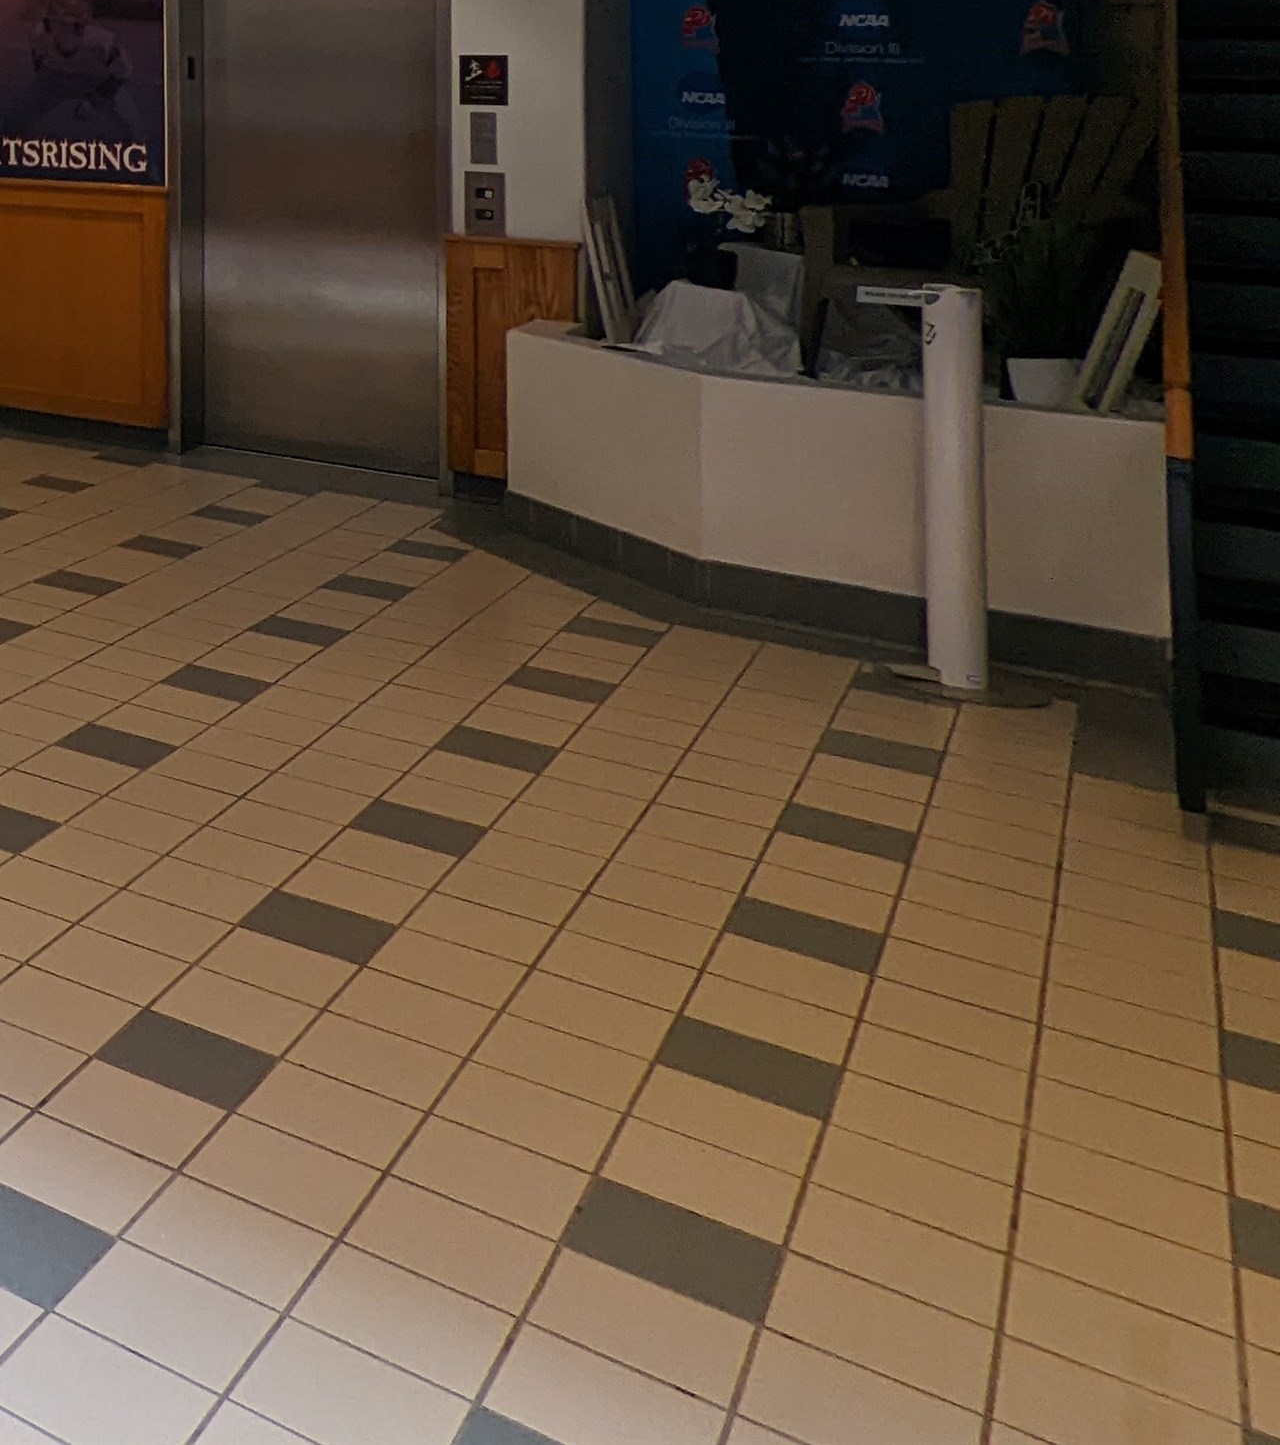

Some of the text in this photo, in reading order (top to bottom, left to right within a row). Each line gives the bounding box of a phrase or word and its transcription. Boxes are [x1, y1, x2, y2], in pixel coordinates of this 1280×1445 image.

[838, 14, 890, 27] NCAA
[824, 41, 884, 55] Division
[681, 91, 728, 105] NCAA
[841, 173, 889, 189] NCAA
